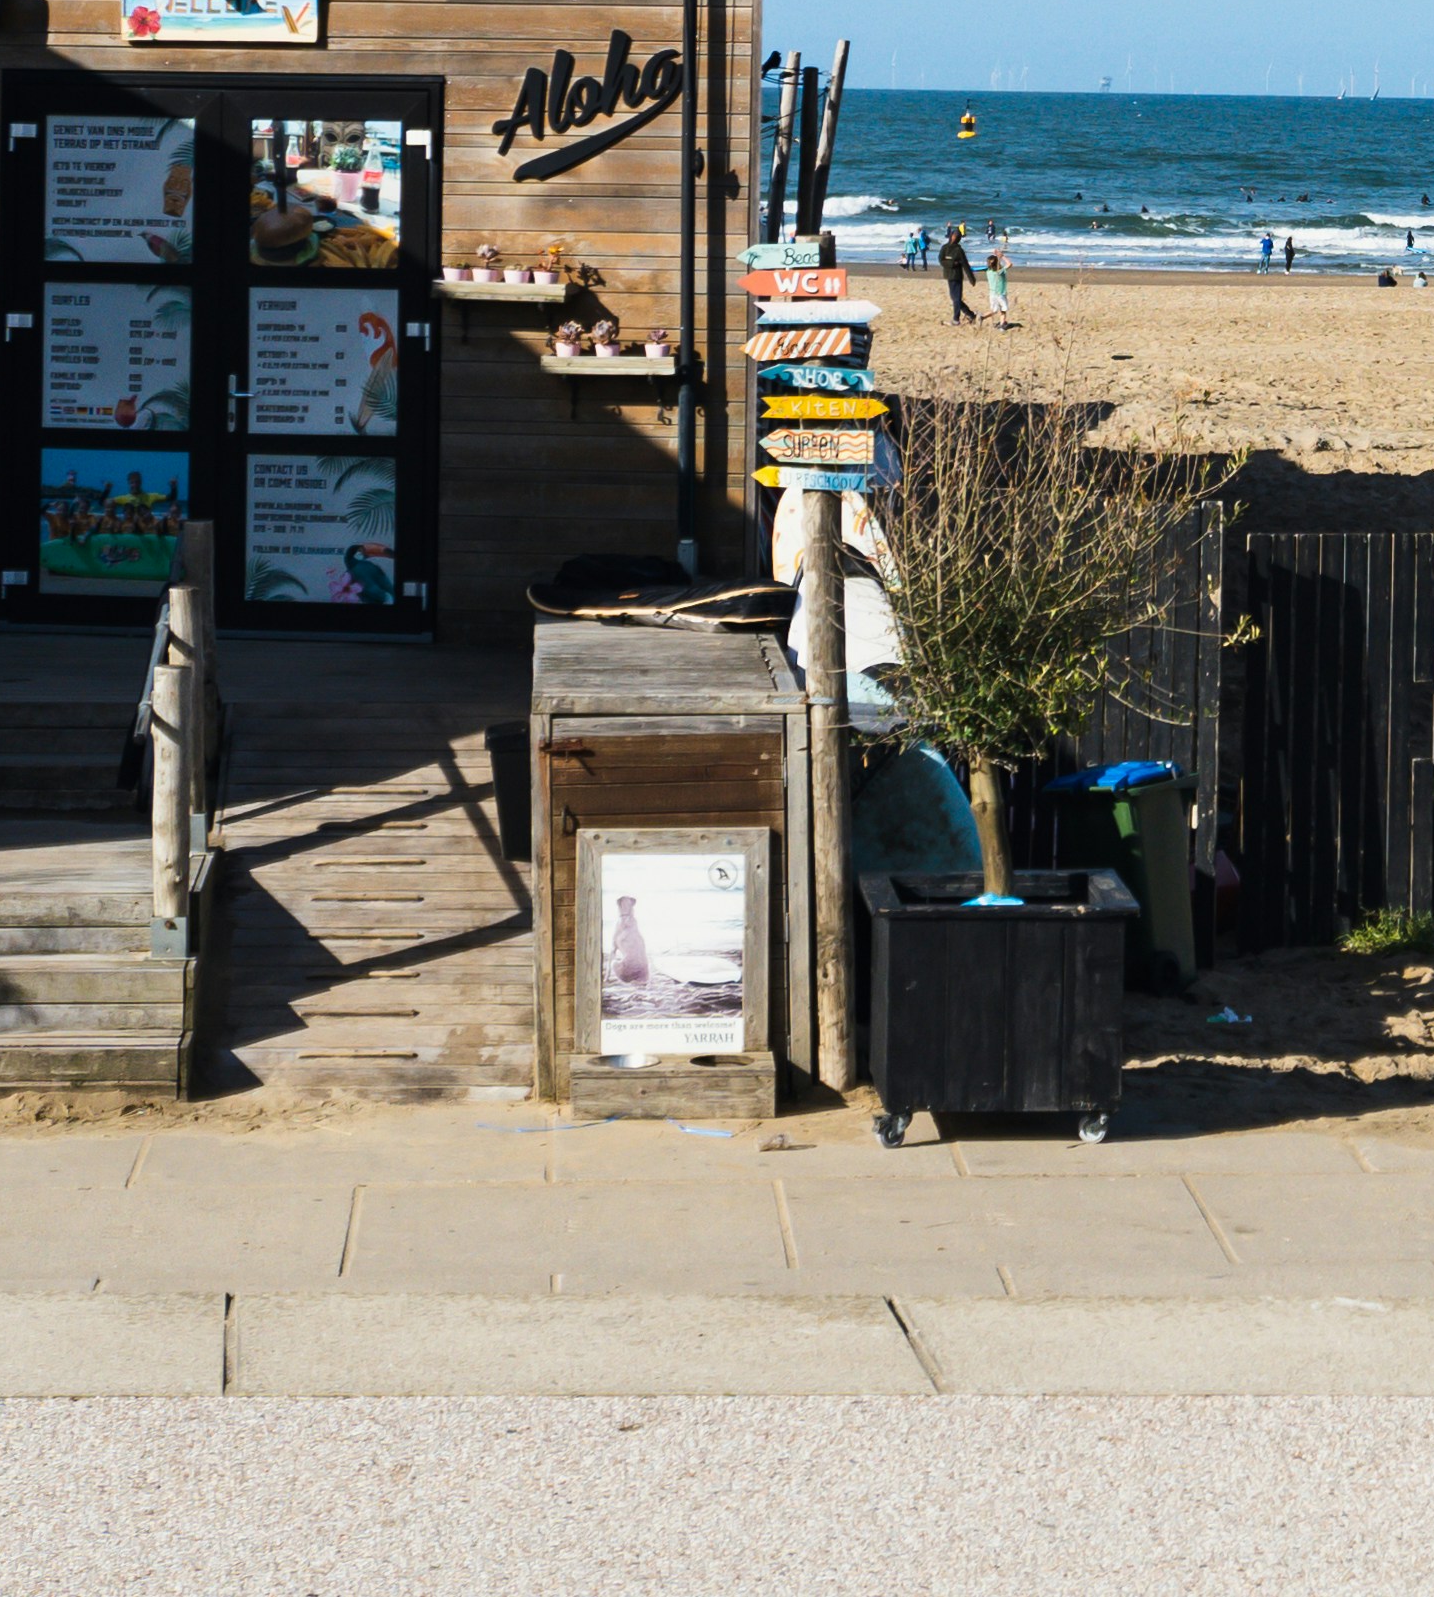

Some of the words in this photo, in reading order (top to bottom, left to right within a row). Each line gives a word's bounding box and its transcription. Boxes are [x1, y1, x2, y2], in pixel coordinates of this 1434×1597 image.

[492, 29, 683, 156] Aloha
[54, 124, 84, 135] GENIET
[87, 125, 104, 136] VAN
[107, 126, 125, 136] ONS
[128, 126, 154, 136] MOOIE
[54, 138, 87, 149] TERRAS
[89, 139, 100, 149] OP
[103, 139, 120, 150] HET
[773, 271, 819, 294] WC
[52, 295, 90, 306] SURFLES
[256, 300, 297, 310] VERHUUR
[792, 368, 843, 388] SHOP
[254, 464, 293, 475] CONTACT
[296, 465, 308, 475] US
[254, 478, 265, 488] OR
[268, 478, 292, 488] COME
[295, 479, 327, 489] INSIDE!
[605, 1022, 626, 1031] Dogs
[694, 1021, 736, 1029] welcome!
[684, 1033, 734, 1044] YARRAH
